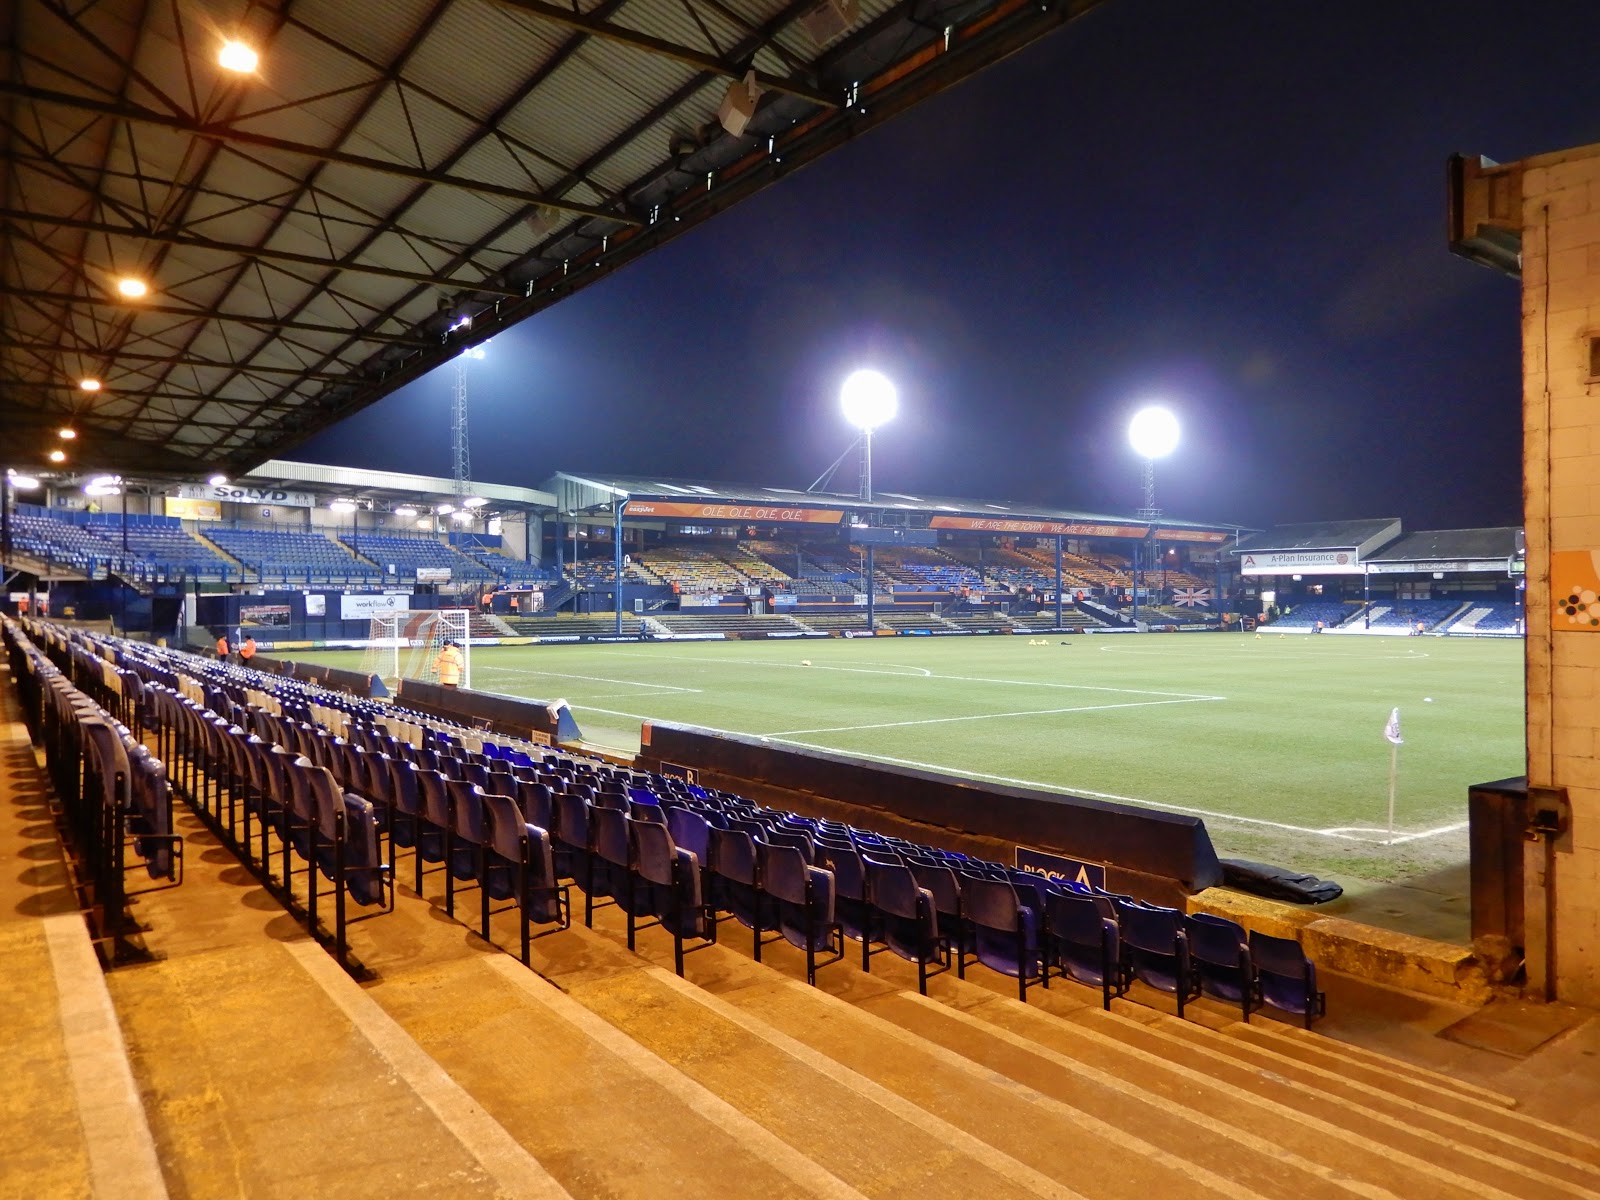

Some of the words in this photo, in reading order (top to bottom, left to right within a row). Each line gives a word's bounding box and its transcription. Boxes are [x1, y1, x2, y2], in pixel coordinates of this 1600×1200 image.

[213, 486, 288, 501] SoLYD
[971, 520, 986, 529] WE
[985, 520, 1003, 529] ARE
[1004, 521, 1021, 531] THE
[1021, 522, 1045, 532] TOWN
[1051, 524, 1064, 532] WE
[1063, 525, 1079, 533] ARE
[1079, 526, 1096, 534] THE
[1271, 554, 1295, 562] A-Plan
[1297, 553, 1334, 562] Insurance
[1417, 562, 1458, 570] STORAGE
[356, 600, 387, 608] workflow
[687, 770, 695, 785] B
[1075, 864, 1092, 892] A
